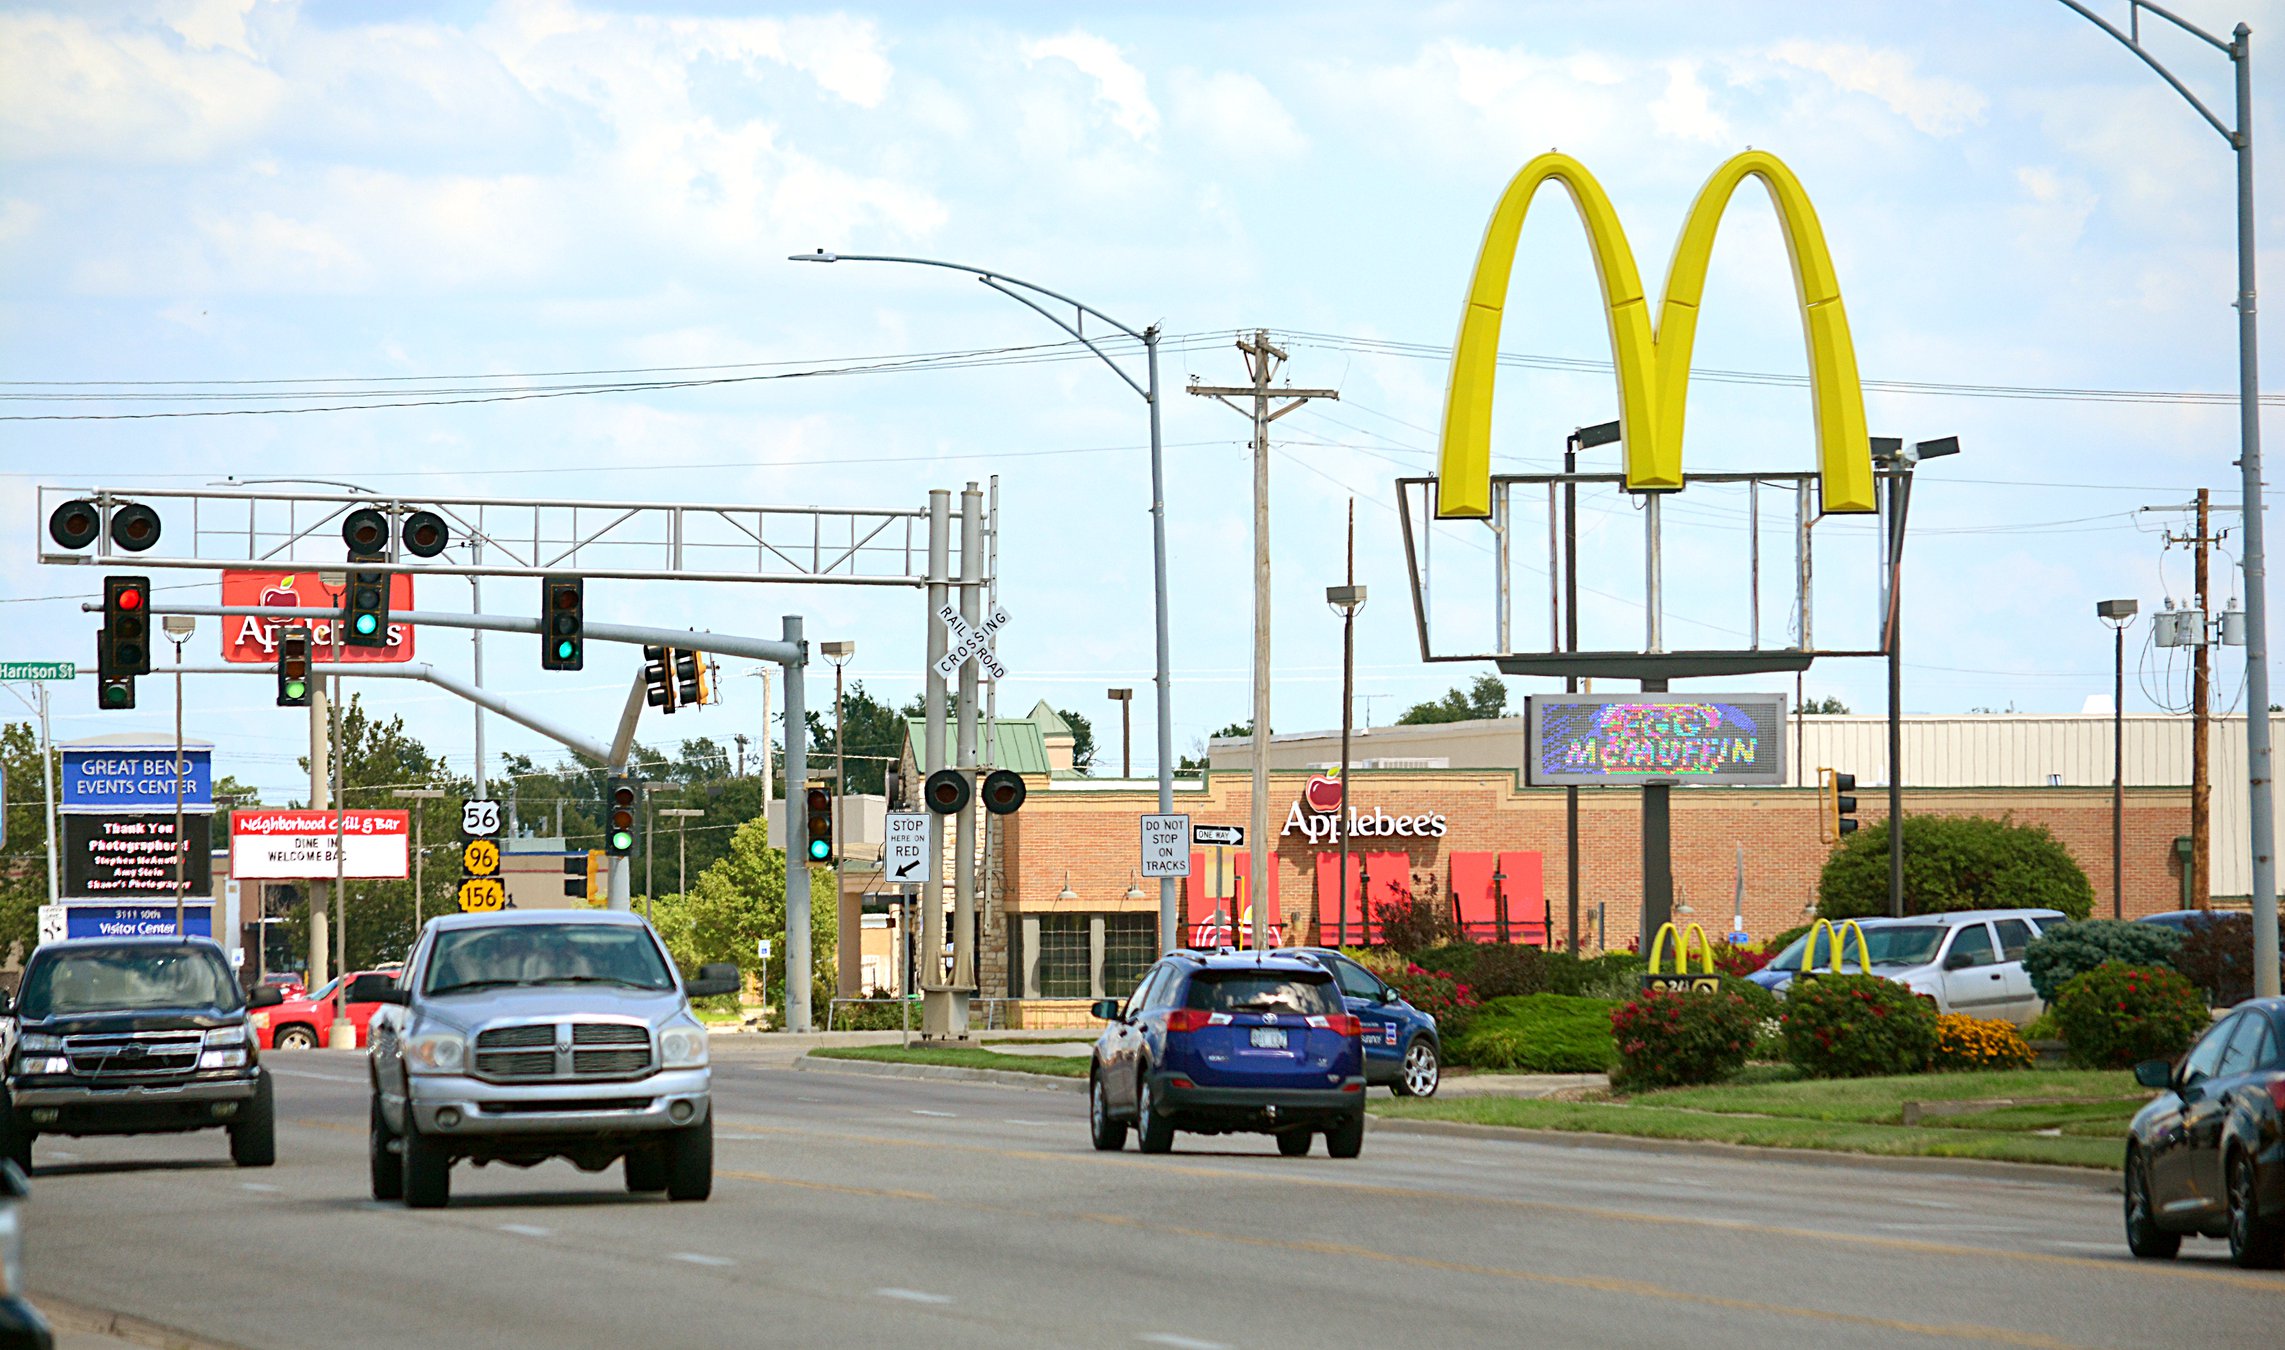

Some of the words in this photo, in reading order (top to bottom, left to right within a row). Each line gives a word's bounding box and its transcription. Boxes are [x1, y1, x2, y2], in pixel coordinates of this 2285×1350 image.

[940, 606, 966, 637] RAIL
[976, 647, 1005, 678] ROAD
[941, 613, 1006, 672] CROSSING
[0, 663, 57, 679] Harrison
[59, 663, 74, 679] St
[81, 759, 140, 776] GREAT
[143, 759, 194, 776] BEND
[77, 780, 135, 794] EVENTS
[137, 780, 197, 794] CENTER
[467, 808, 496, 828] 56
[1280, 800, 1448, 844] Applebee's
[103, 822, 146, 834] Thank
[148, 822, 175, 834] You
[240, 815, 327, 834] Neighborhood
[373, 817, 401, 831] Bar
[893, 820, 924, 831] STOP
[1146, 821, 1160, 831] DO
[1164, 820, 1184, 831] NOT
[891, 834, 910, 842] HERE
[914, 834, 925, 842] ON
[1152, 833, 1178, 845] STOP
[1198, 830, 1213, 839] ONE
[1215, 831, 1230, 840] WAY
[88, 839, 191, 854] Photographer!
[295, 837, 319, 848] DINE
[268, 851, 322, 862] WELCOME
[470, 847, 493, 868] 96
[896, 846, 920, 857] RED
[1158, 848, 1173, 857] ON
[1146, 860, 1187, 871] TRACKS
[113, 867, 138, 878] Amy
[465, 887, 497, 907] 156
[115, 909, 138, 919] 3111
[100, 921, 137, 935] Visitor
[137, 921, 177, 935] Center
